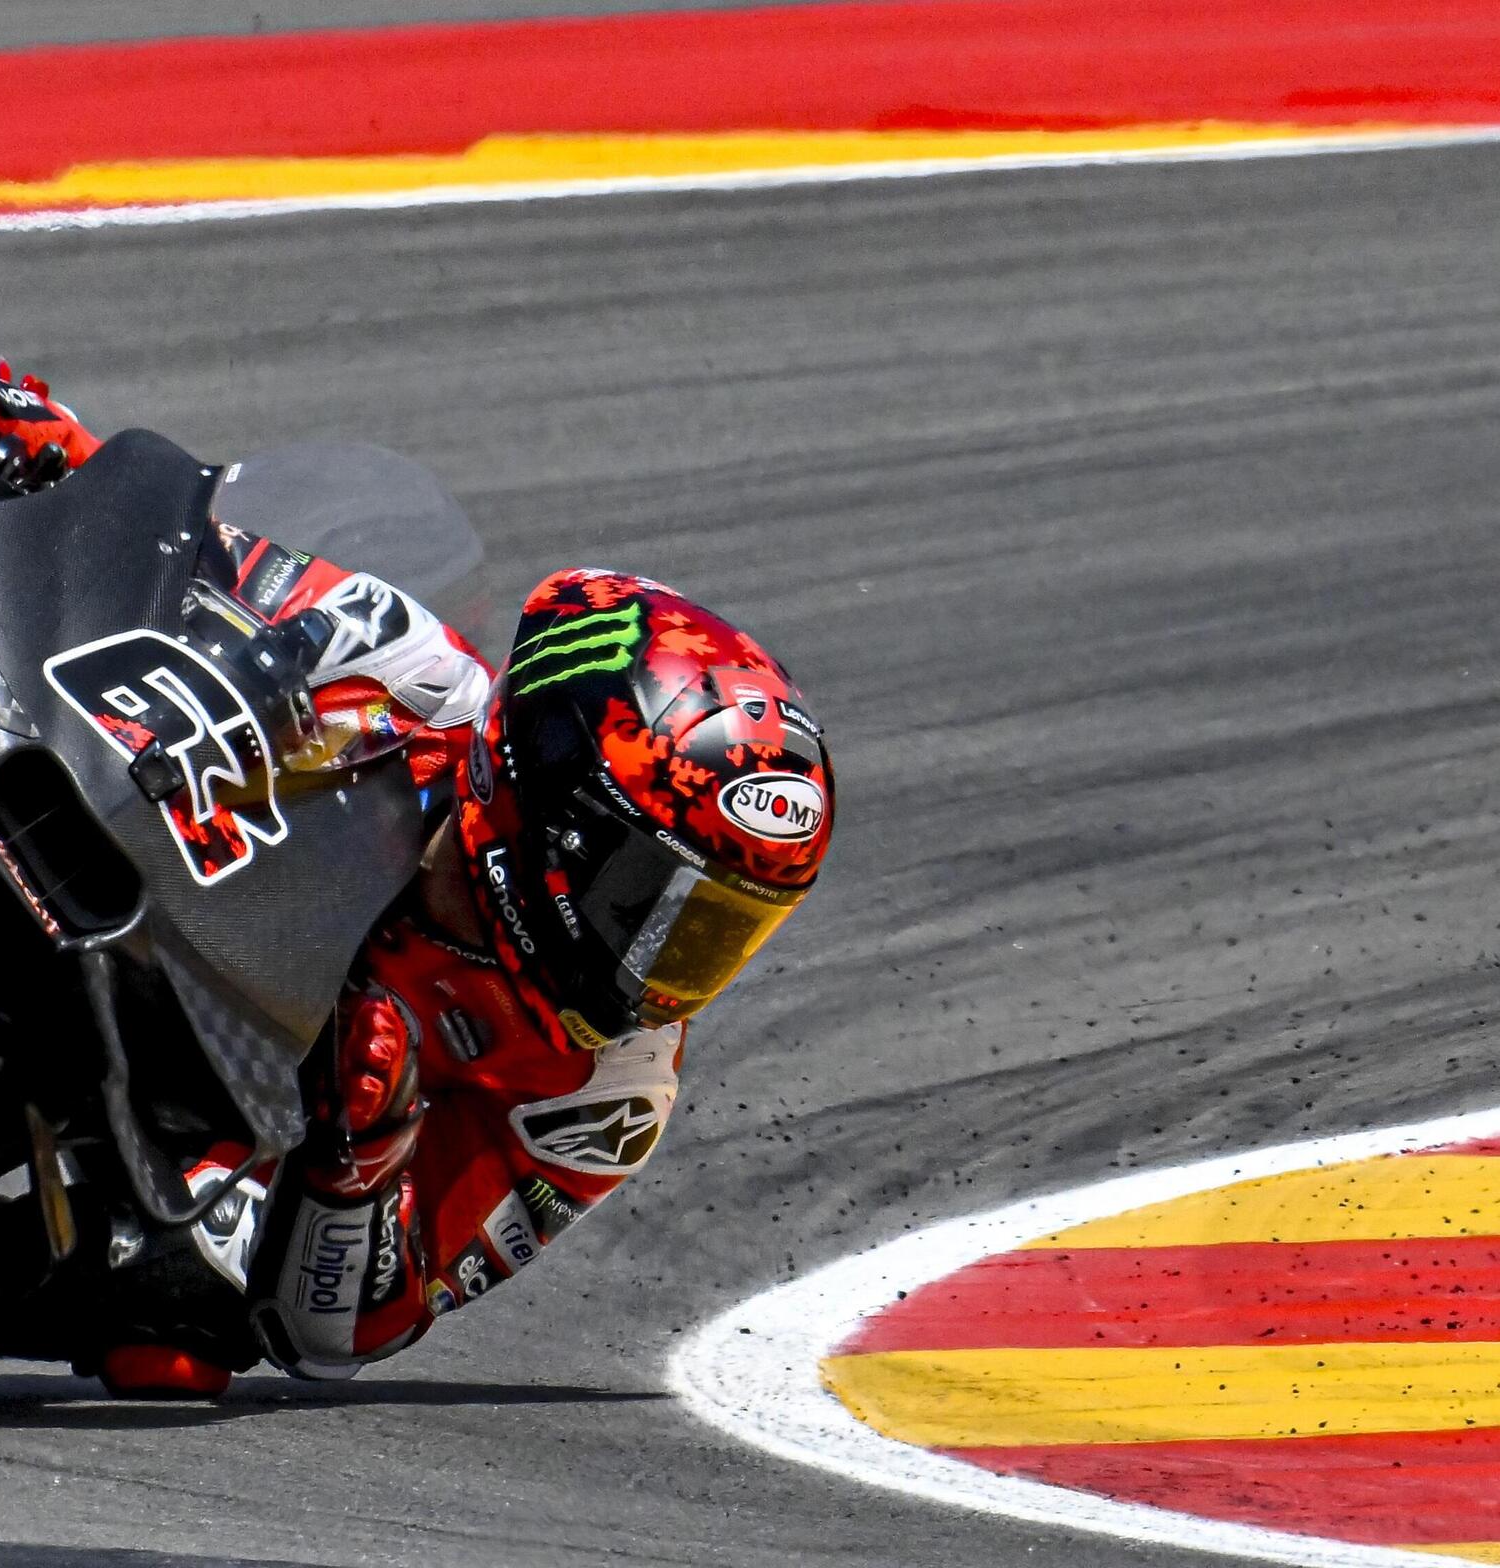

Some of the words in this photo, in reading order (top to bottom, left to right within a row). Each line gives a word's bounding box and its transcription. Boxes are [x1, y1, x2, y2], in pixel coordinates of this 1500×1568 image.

[737, 783, 821, 832] SUOMY
[486, 847, 536, 954] Lenovo
[299, 1223, 367, 1314] Unipol
[371, 1192, 399, 1300] Lenovo
